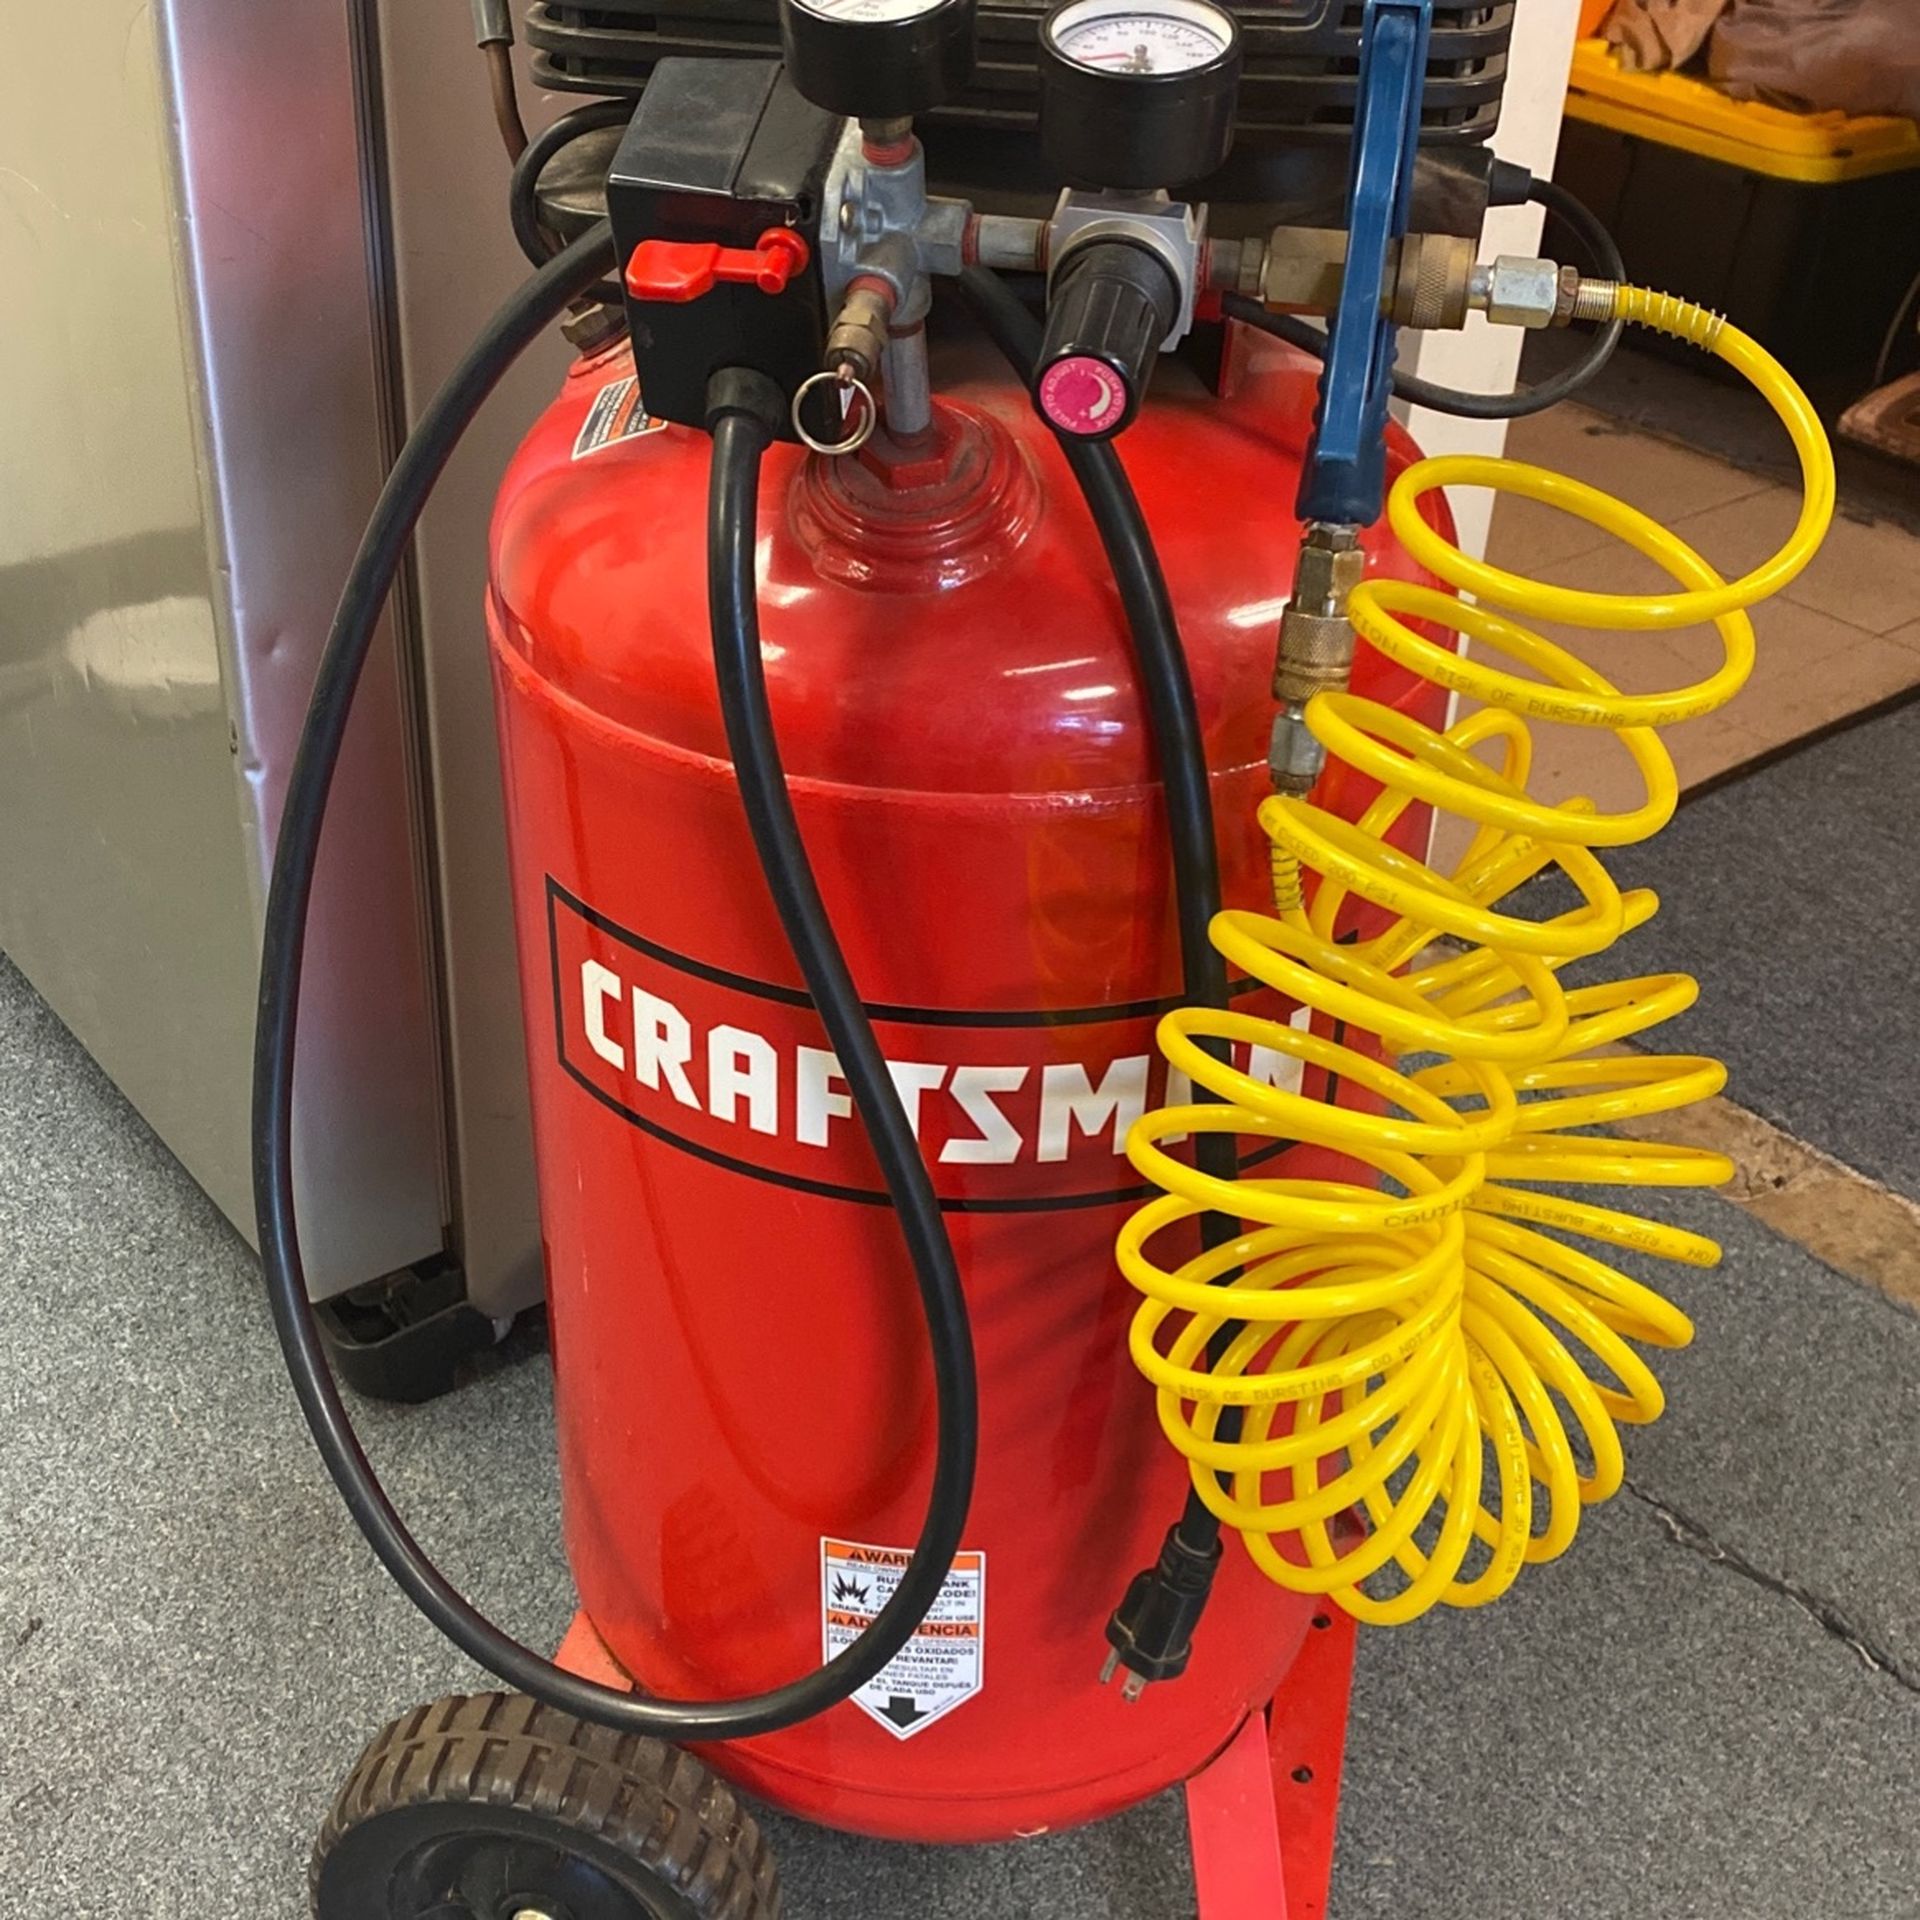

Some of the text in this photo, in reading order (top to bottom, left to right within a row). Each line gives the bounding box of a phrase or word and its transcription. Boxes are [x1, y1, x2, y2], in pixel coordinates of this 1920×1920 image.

[1434, 664, 1479, 694] RISK
[1491, 687, 1515, 703] OF
[1528, 700, 1625, 726] BURSTING
[581, 958, 1311, 1165] CRAFTSMN
[1502, 1199, 1585, 1227] BURSTING
[1253, 1373, 1343, 1400] BURSTING
[914, 1647, 975, 1656] OXIDADOS
